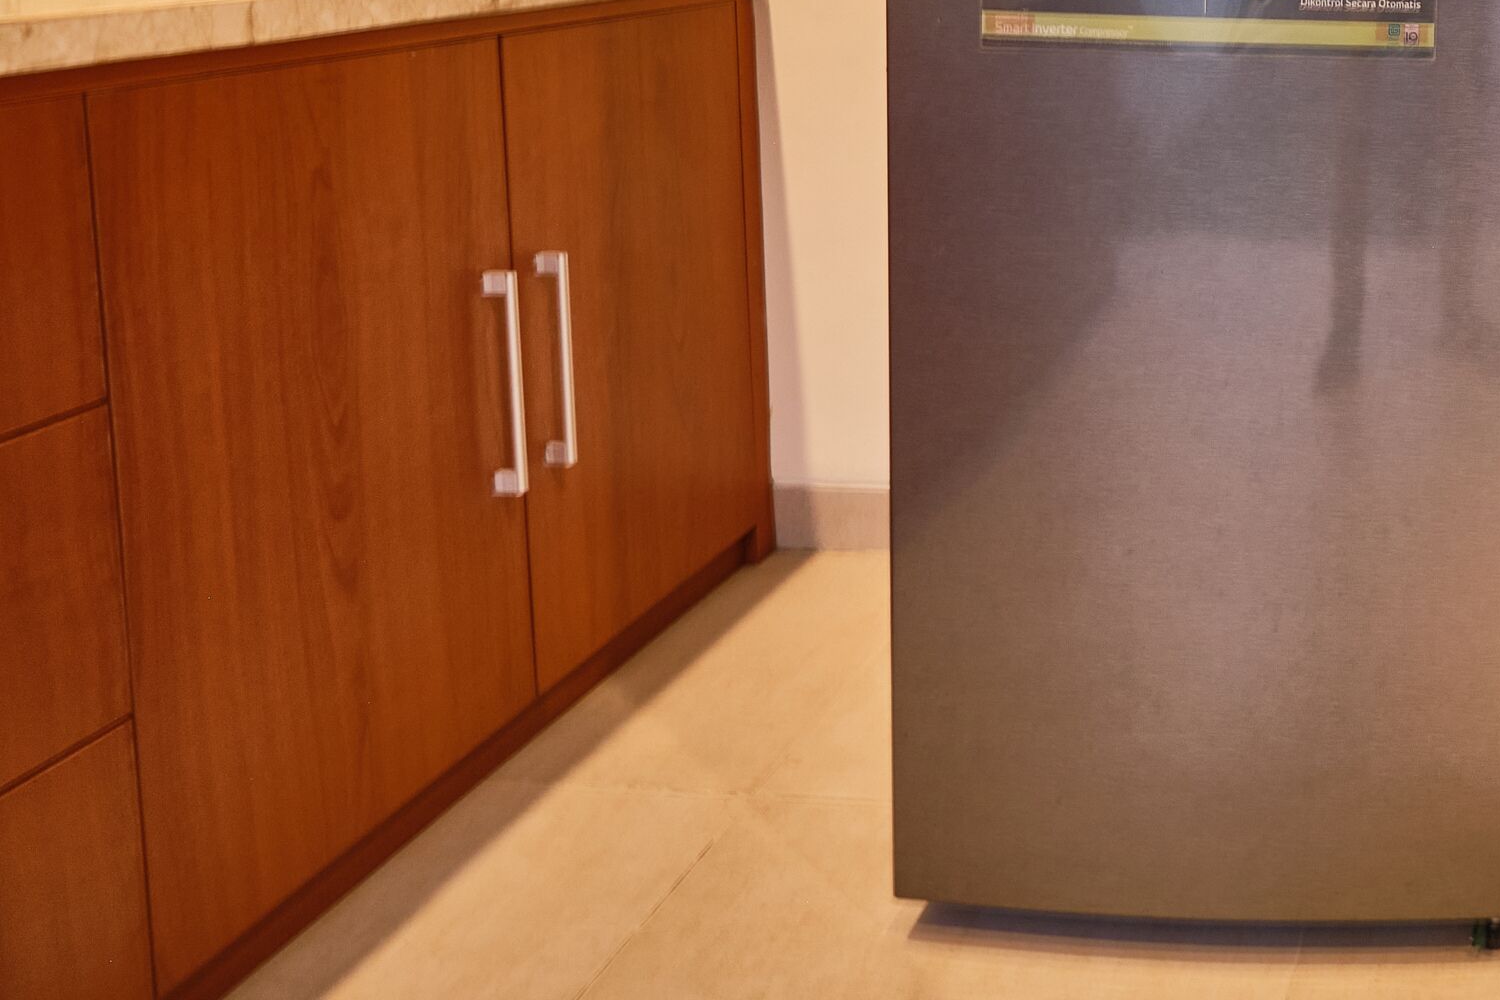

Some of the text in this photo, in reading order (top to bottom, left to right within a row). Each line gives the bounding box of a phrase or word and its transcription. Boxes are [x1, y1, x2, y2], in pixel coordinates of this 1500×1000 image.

[1378, 0, 1421, 9] Otomatis
[995, 21, 1031, 34] Smart
[1032, 24, 1077, 36] Inverter
